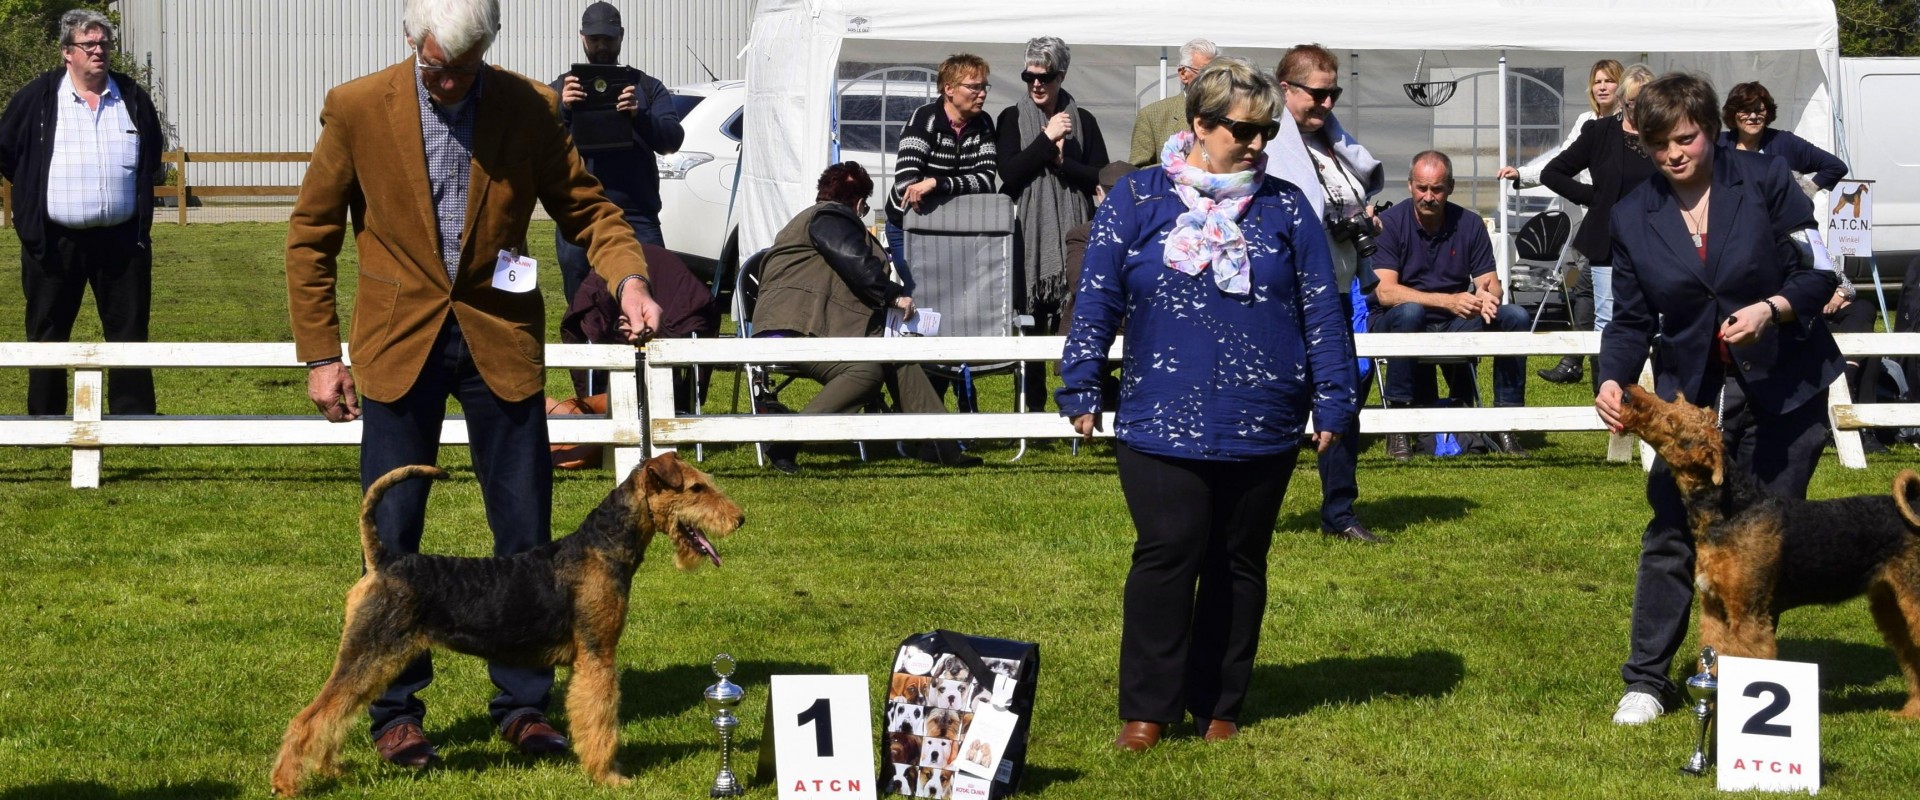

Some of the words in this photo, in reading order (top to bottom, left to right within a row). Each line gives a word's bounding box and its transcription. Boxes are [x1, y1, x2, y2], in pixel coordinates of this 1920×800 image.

[1829, 218, 1872, 231] A.T.C.N.
[1838, 235, 1860, 244] Winkel
[508, 270, 516, 282] 6
[1741, 681, 1792, 738] 2
[797, 698, 835, 757] 1
